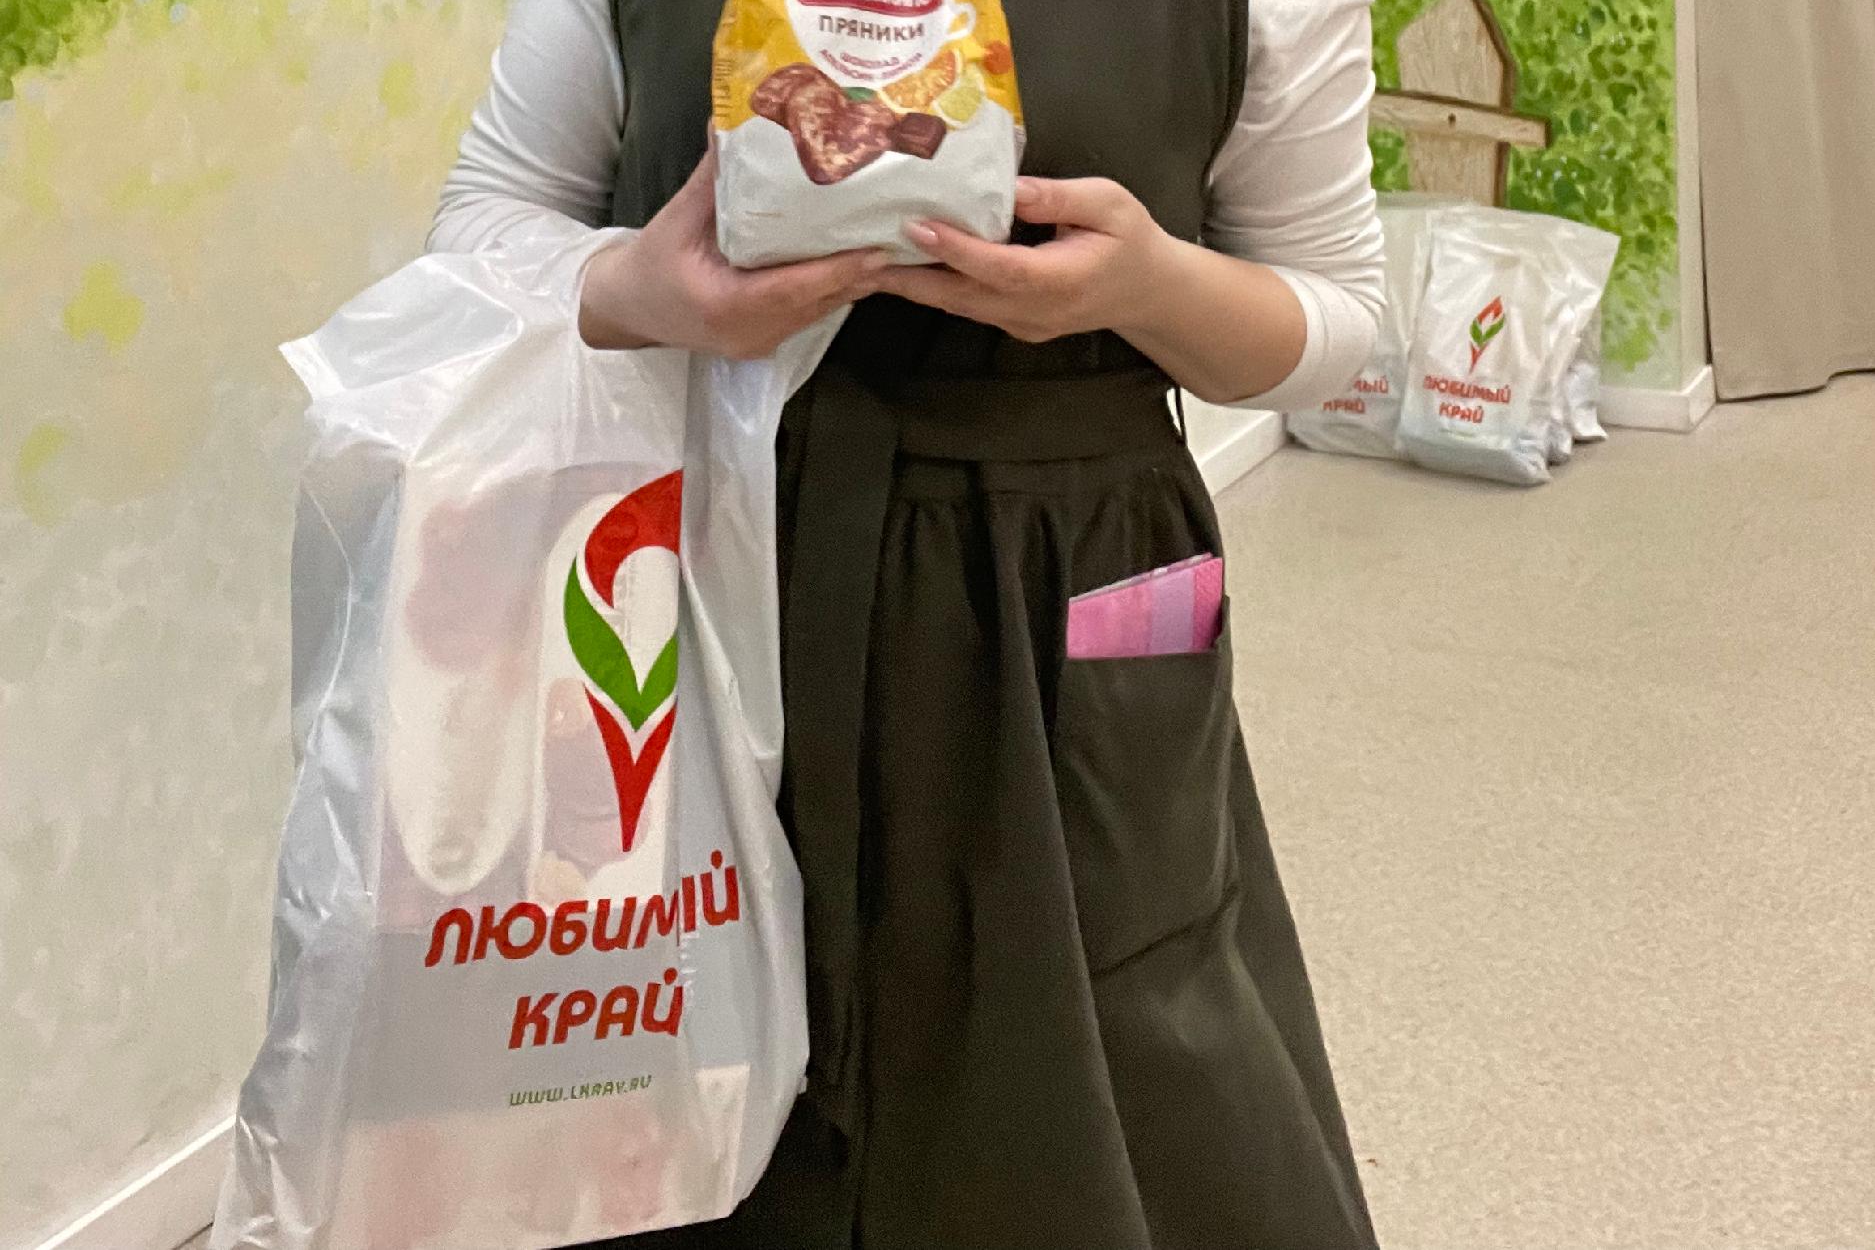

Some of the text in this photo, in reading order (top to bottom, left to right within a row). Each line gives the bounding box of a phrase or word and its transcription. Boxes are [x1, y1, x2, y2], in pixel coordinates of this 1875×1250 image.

[819, 15, 924, 42] ПРЯНИКИ
[1439, 402, 1485, 424] КРАЙ
[508, 967, 684, 1050] КРАЙ
